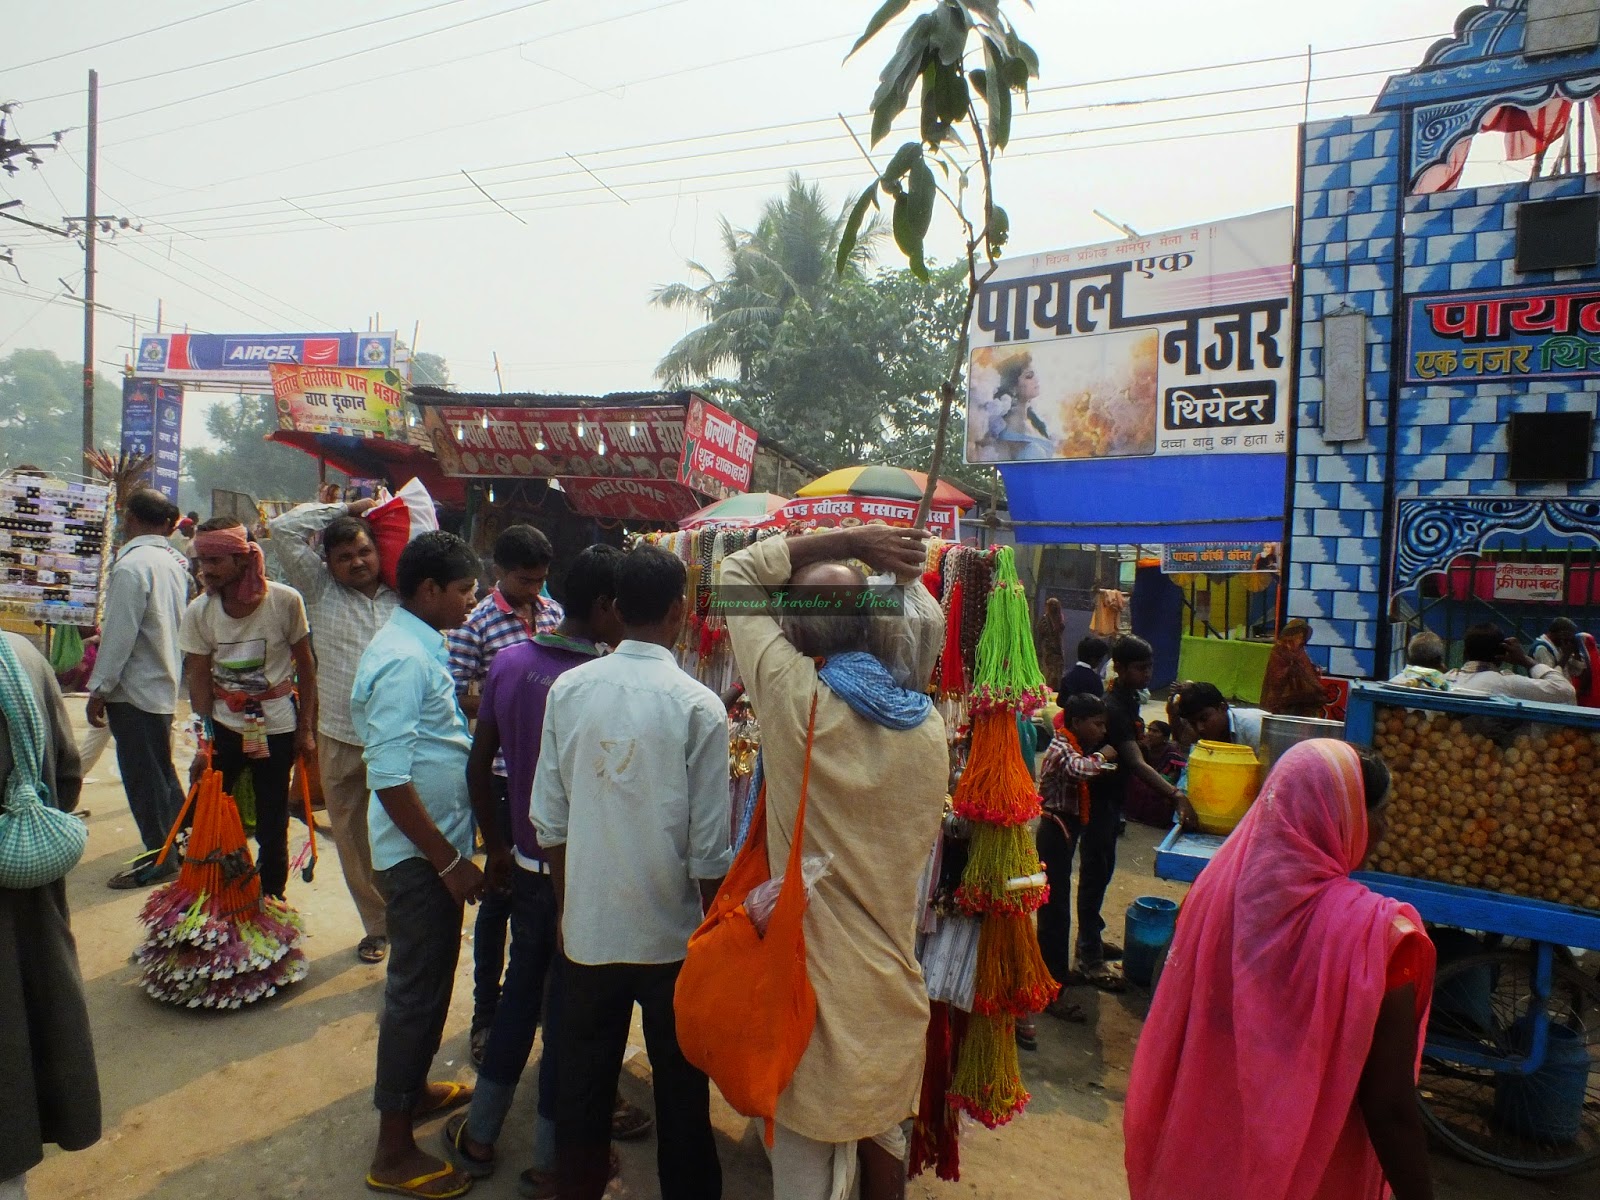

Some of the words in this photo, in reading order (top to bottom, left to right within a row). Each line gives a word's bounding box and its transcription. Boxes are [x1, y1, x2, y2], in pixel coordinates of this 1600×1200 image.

[1160, 234, 1182, 246] मेला
[976, 261, 1132, 342] पायल
[1133, 250, 1195, 279] एक
[1157, 298, 1288, 376] नजर
[229, 345, 299, 360] AIRCEL
[1415, 350, 1458, 379] एक
[1462, 345, 1533, 374] नजर
[345, 373, 368, 394] पान
[304, 391, 328, 407] चाय
[331, 394, 366, 413] दूकान
[1171, 388, 1270, 425] थियेटर
[704, 413, 737, 453] कल्याणी
[736, 426, 757, 463] होटल
[1220, 436, 1238, 446] का
[1243, 434, 1268, 447] हाता
[1274, 430, 1285, 444] में
[588, 480, 666, 504] WELCOME
